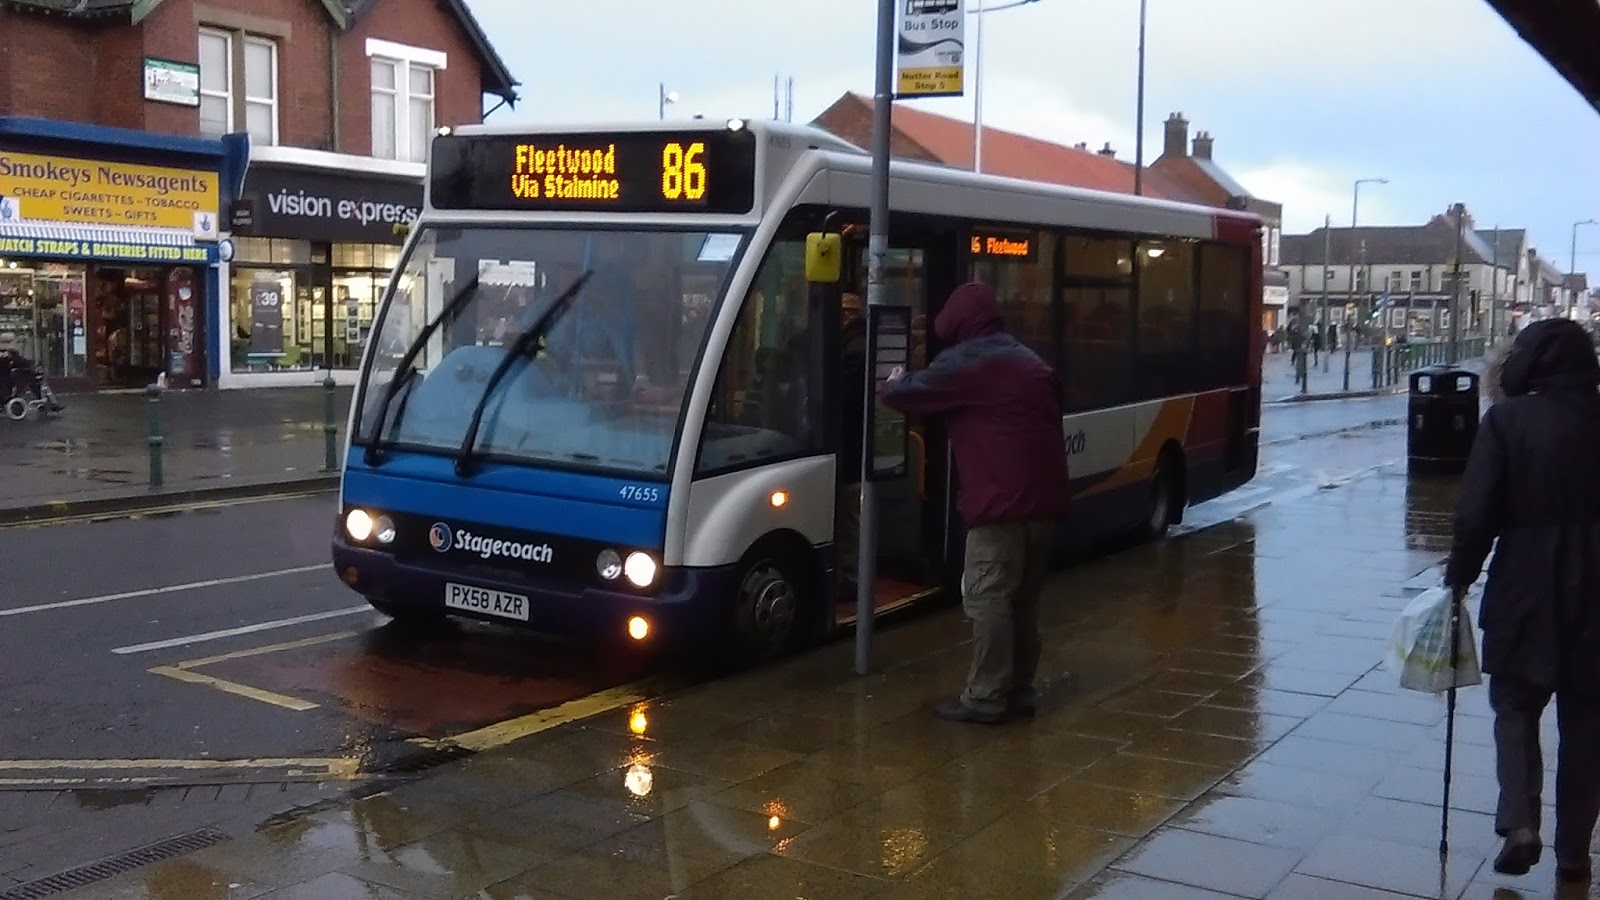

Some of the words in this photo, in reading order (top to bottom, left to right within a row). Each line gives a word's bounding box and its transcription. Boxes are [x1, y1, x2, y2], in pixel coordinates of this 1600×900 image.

[905, 20, 926, 31] Bus
[931, 18, 959, 30] Stop
[935, 71, 959, 80] Road
[515, 143, 615, 174] Fleetwood
[662, 142, 706, 199] 86
[0, 156, 91, 187] Smokeys
[98, 166, 207, 195] Newsagents
[511, 174, 540, 198] Via
[544, 174, 620, 199] Stalmine
[13, 186, 56, 198] CHEAP
[60, 190, 134, 205] CIGARETTES
[145, 196, 199, 210] TOBACCO
[268, 188, 331, 218] vision
[338, 198, 417, 227] express
[63, 205, 112, 219] SWEETS
[125, 210, 157, 221] GIFTS
[37, 240, 79, 255] STRAPS
[81, 243, 91, 256] &
[93, 244, 147, 258] BATTERIES
[148, 246, 181, 260] FITTED
[183, 247, 208, 261] HERE
[986, 237, 1029, 255] Fleetwood
[619, 486, 658, 501] 47655
[454, 529, 552, 563] Stagecoach
[451, 586, 490, 610] PX58
[493, 592, 524, 616] AZR
